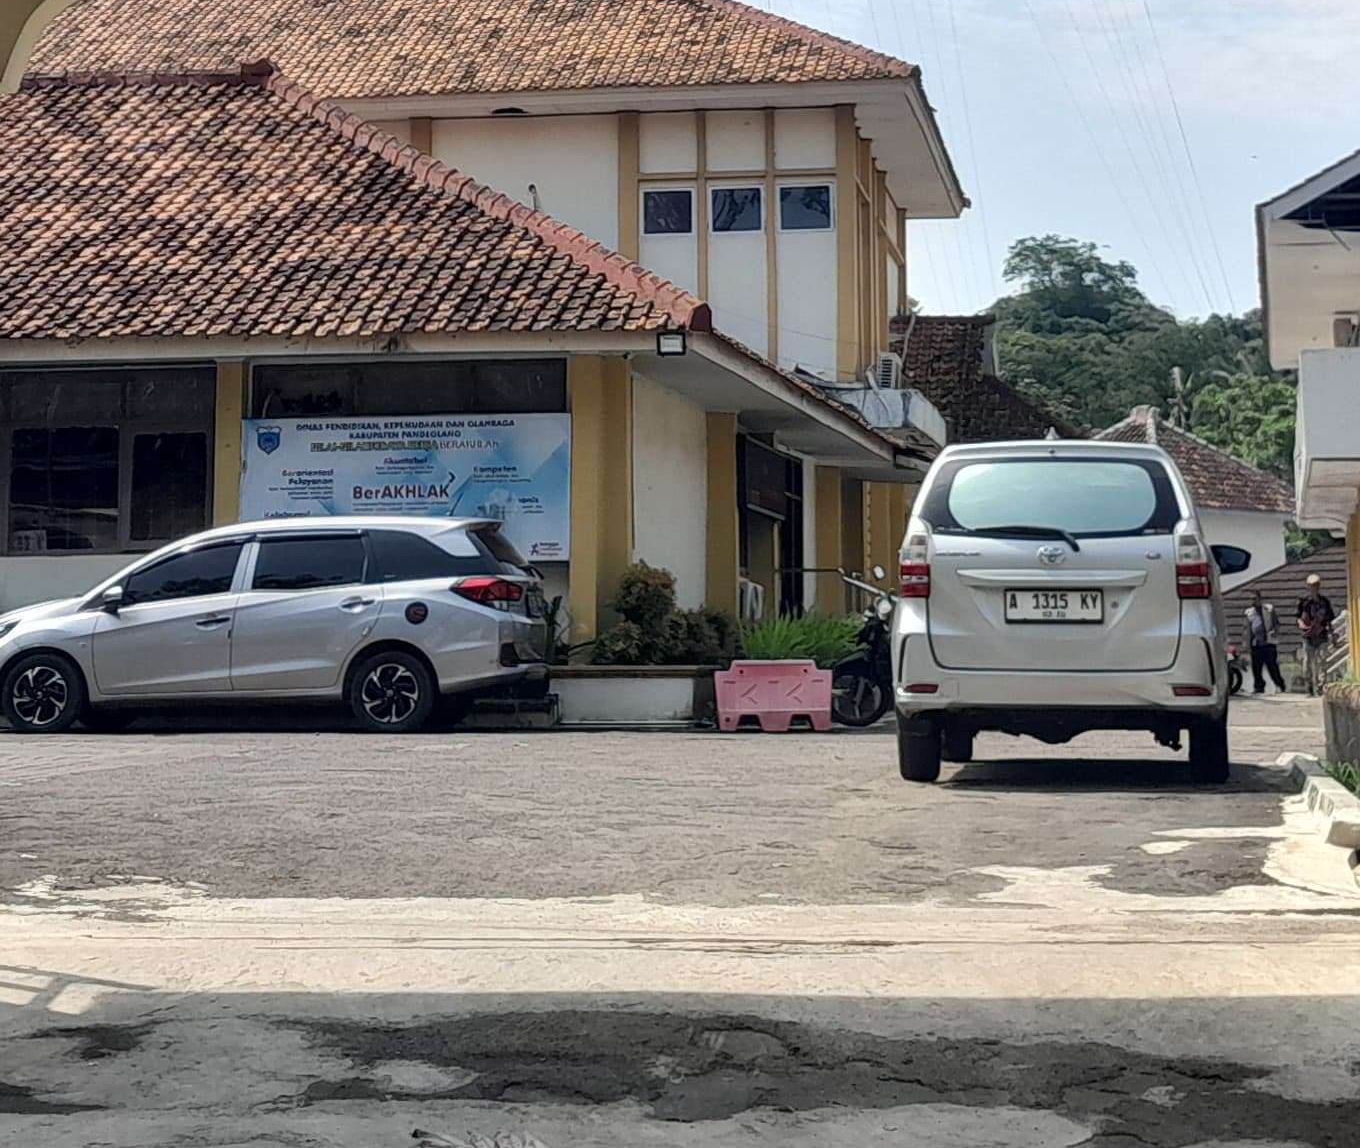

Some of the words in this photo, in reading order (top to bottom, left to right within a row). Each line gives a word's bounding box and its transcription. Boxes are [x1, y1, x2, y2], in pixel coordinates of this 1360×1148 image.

[445, 420, 465, 428] DAN
[352, 483, 450, 499] BerAKHLAK
[1008, 593, 1018, 609] A
[1032, 593, 1069, 610] 1315
[1080, 593, 1099, 610] KY
